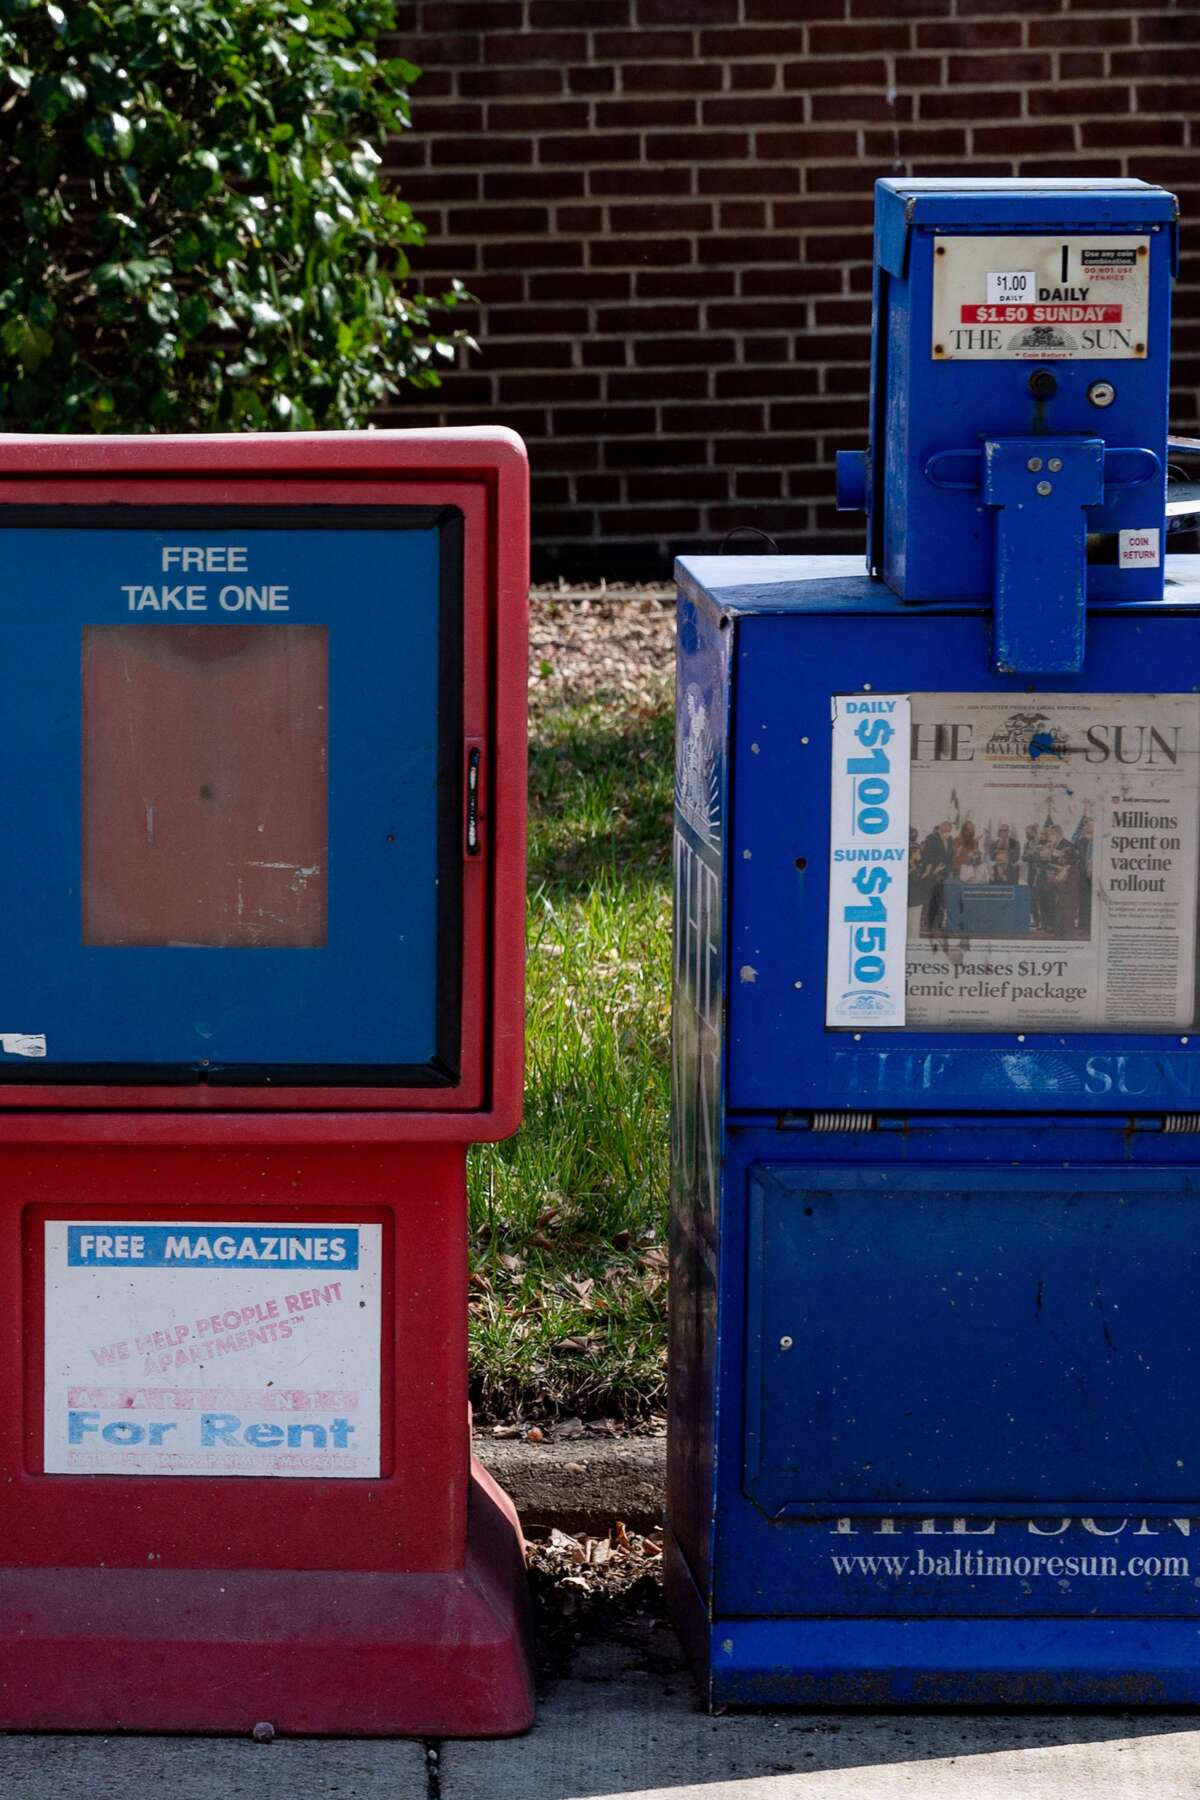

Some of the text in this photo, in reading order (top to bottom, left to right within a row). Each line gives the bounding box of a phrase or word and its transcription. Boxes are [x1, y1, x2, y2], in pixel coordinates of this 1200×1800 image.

[996, 275, 1027, 291] $1.00
[1038, 287, 1090, 302] DAILY
[976, 306, 1107, 323] $1.50 SUNDAY
[950, 329, 1132, 350] THE SUN
[1129, 538, 1149, 546] COIN
[162, 547, 248, 572] FREE
[1123, 550, 1155, 559] RETURN
[121, 585, 290, 611] TAKE ONE
[845, 701, 897, 714] DAILY
[911, 722, 1185, 765] HE SUN
[1112, 811, 1178, 829] Millions
[1111, 835, 1181, 853] spent on
[833, 848, 905, 862] SUNDAY
[1111, 854, 1172, 871] vaccine
[1110, 874, 1166, 892] rollout
[906, 960, 1068, 979] gress passes $1.9T
[959, 980, 1010, 998] relief
[1011, 983, 1088, 1002] package
[80, 1235, 347, 1261] FREE MAGAZINES
[91, 1282, 343, 1367] WE HELP PEOPLE RENT
[68, 1411, 356, 1448] For Rent
[831, 1550, 1190, 1577] www.baltimoresun.com
